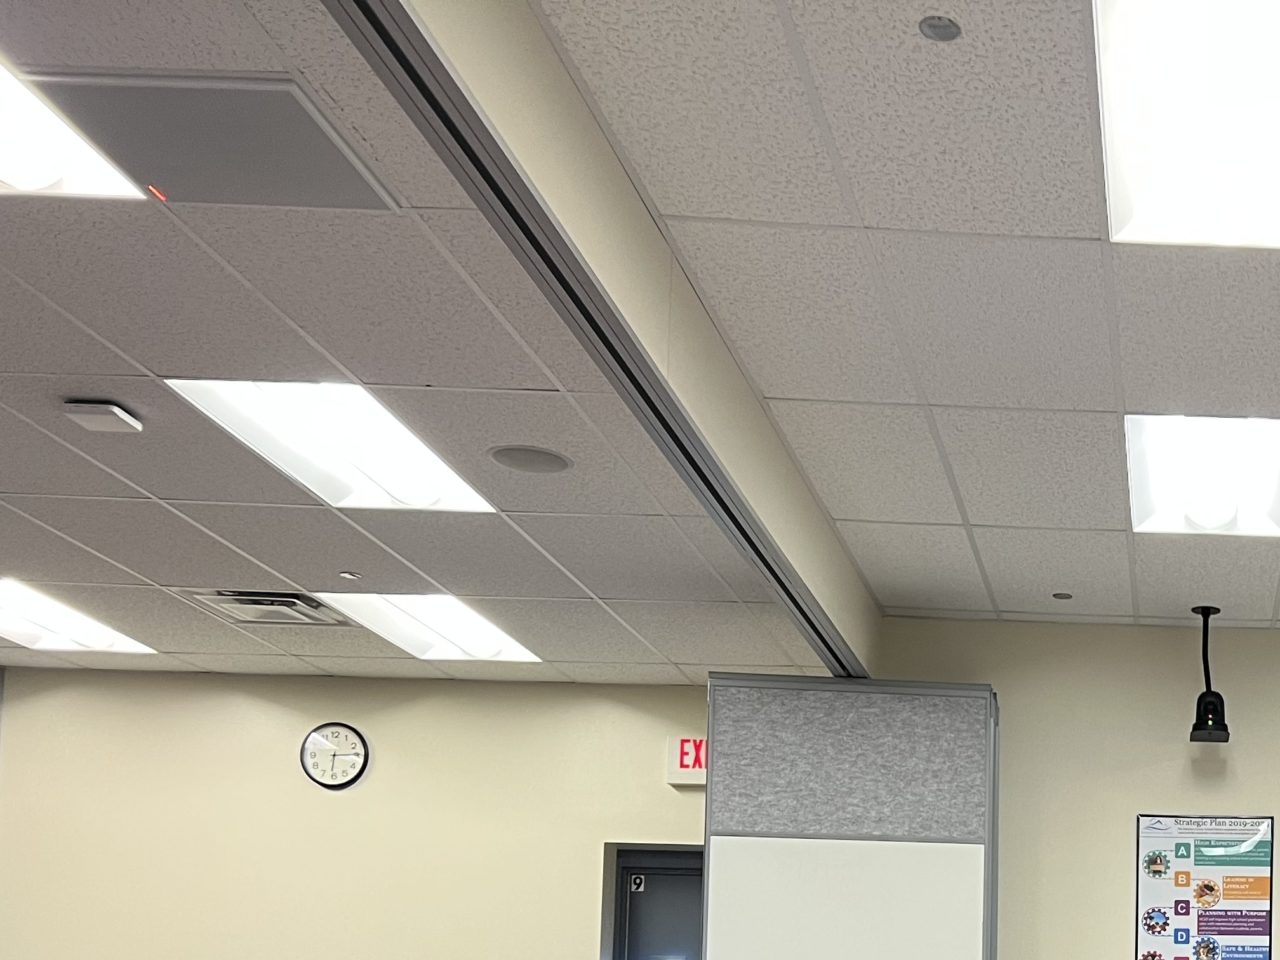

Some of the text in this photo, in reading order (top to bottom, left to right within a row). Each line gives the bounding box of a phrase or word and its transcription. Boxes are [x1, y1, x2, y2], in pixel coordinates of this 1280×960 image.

[680, 739, 708, 769] EXI
[1174, 819, 1208, 828] Strategic
[1178, 847, 1186, 856] A
[632, 876, 643, 890] 9
[1178, 875, 1186, 884] B
[1178, 904, 1186, 913] C
[1178, 932, 1186, 941] D
